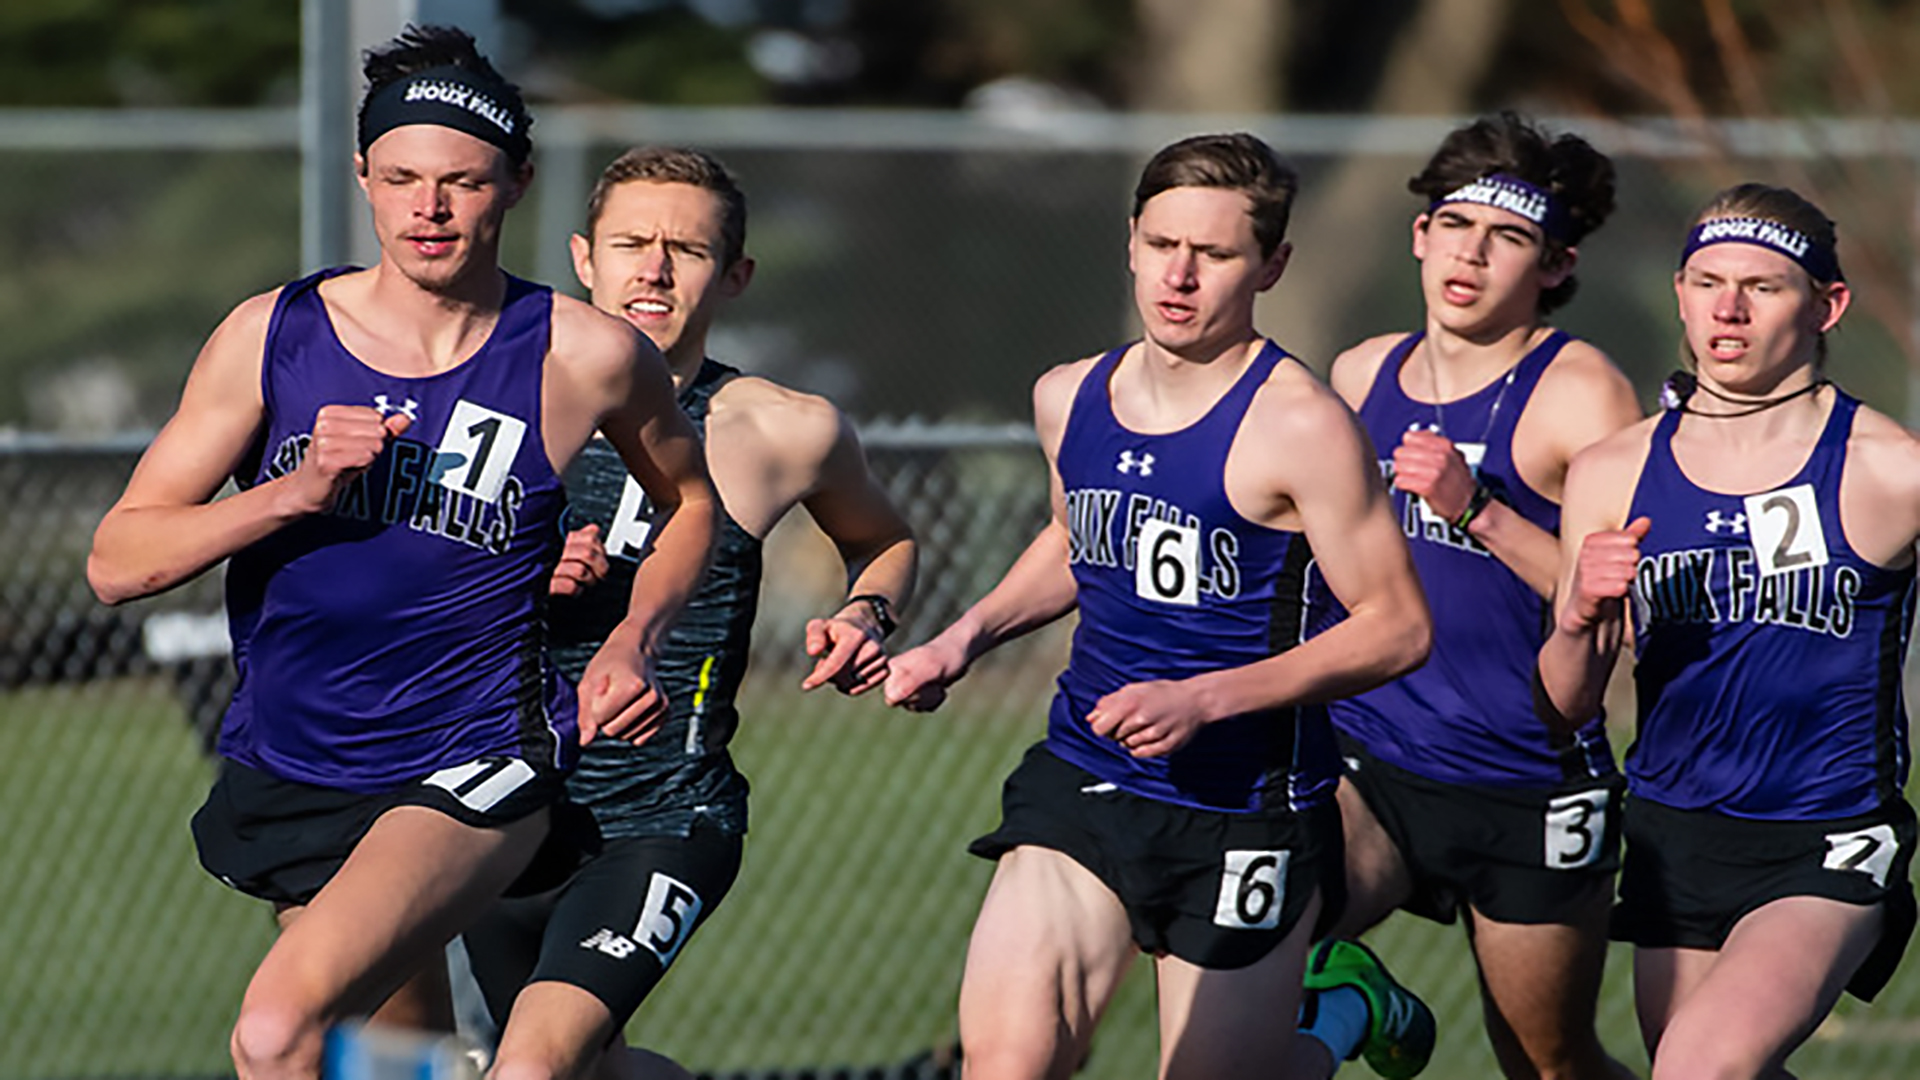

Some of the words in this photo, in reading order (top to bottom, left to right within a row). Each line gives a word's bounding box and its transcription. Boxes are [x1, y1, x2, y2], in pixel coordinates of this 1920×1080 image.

[404, 84, 467, 107] SIOUX
[467, 96, 515, 135] FALLS
[1492, 189, 1547, 222] FALLS
[1756, 224, 1809, 258] FALLS
[462, 416, 502, 491] 1
[381, 440, 526, 555] FALLS
[1760, 494, 1813, 569] 2
[1150, 528, 1186, 599] 6
[1727, 545, 1862, 639] FALLS
[1548, 799, 1593, 863] 3
[648, 882, 696, 955] 5
[1235, 855, 1278, 925] 6
